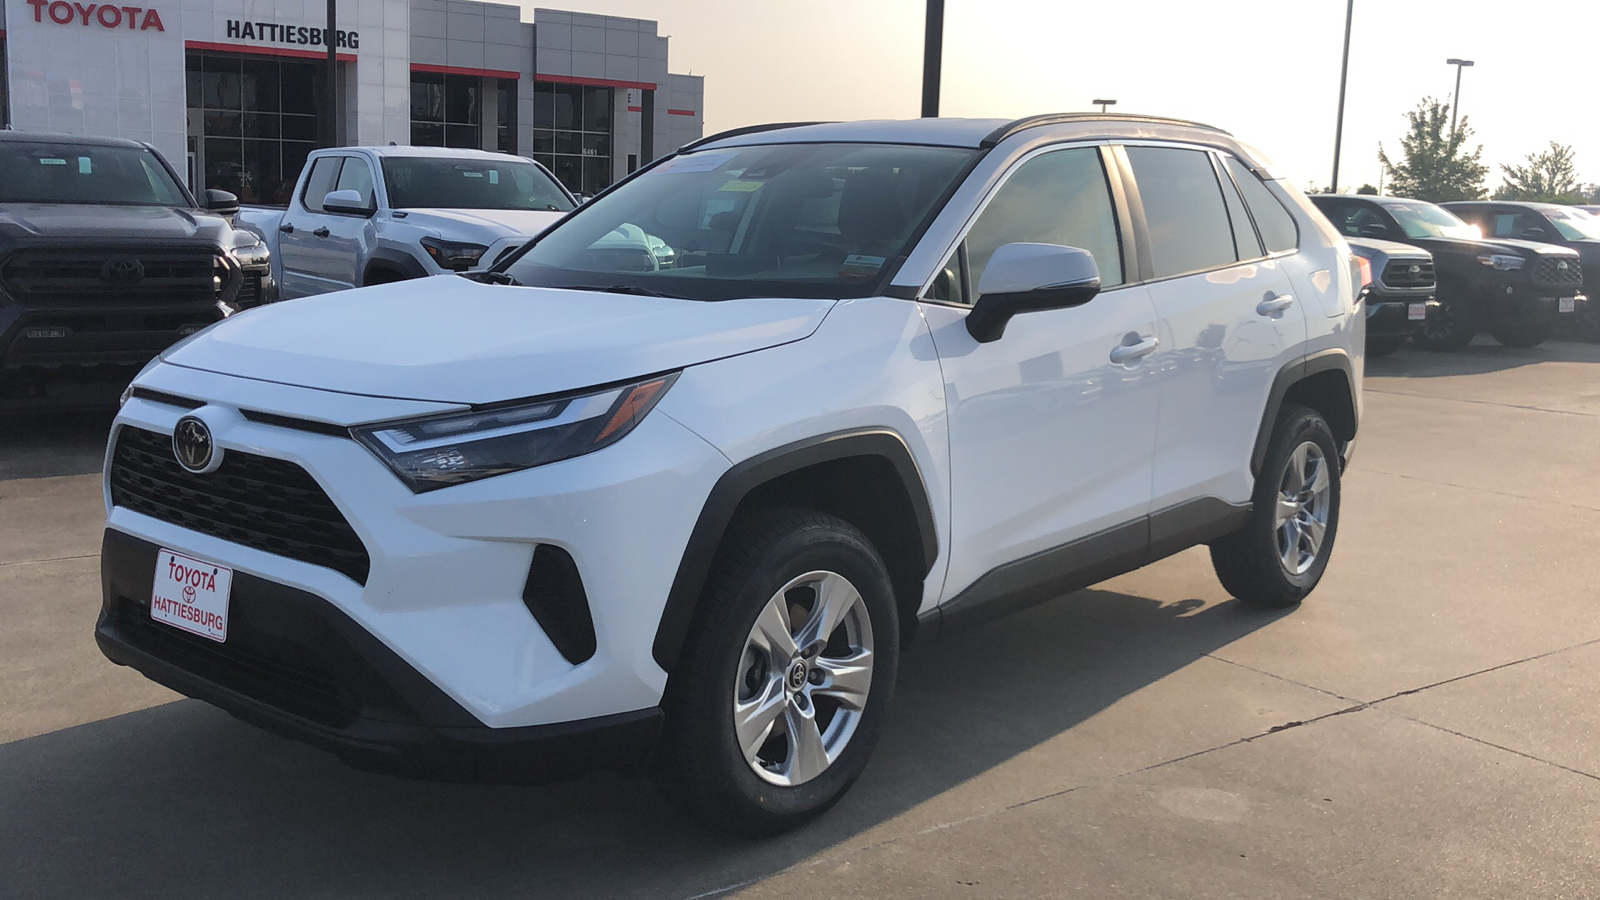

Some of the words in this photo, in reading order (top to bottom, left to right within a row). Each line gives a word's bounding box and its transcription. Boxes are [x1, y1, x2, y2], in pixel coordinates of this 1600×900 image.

[27, 0, 165, 32] TOYOTA
[169, 561, 215, 592] TOYOTA
[154, 595, 223, 631] HATTIESBURG
